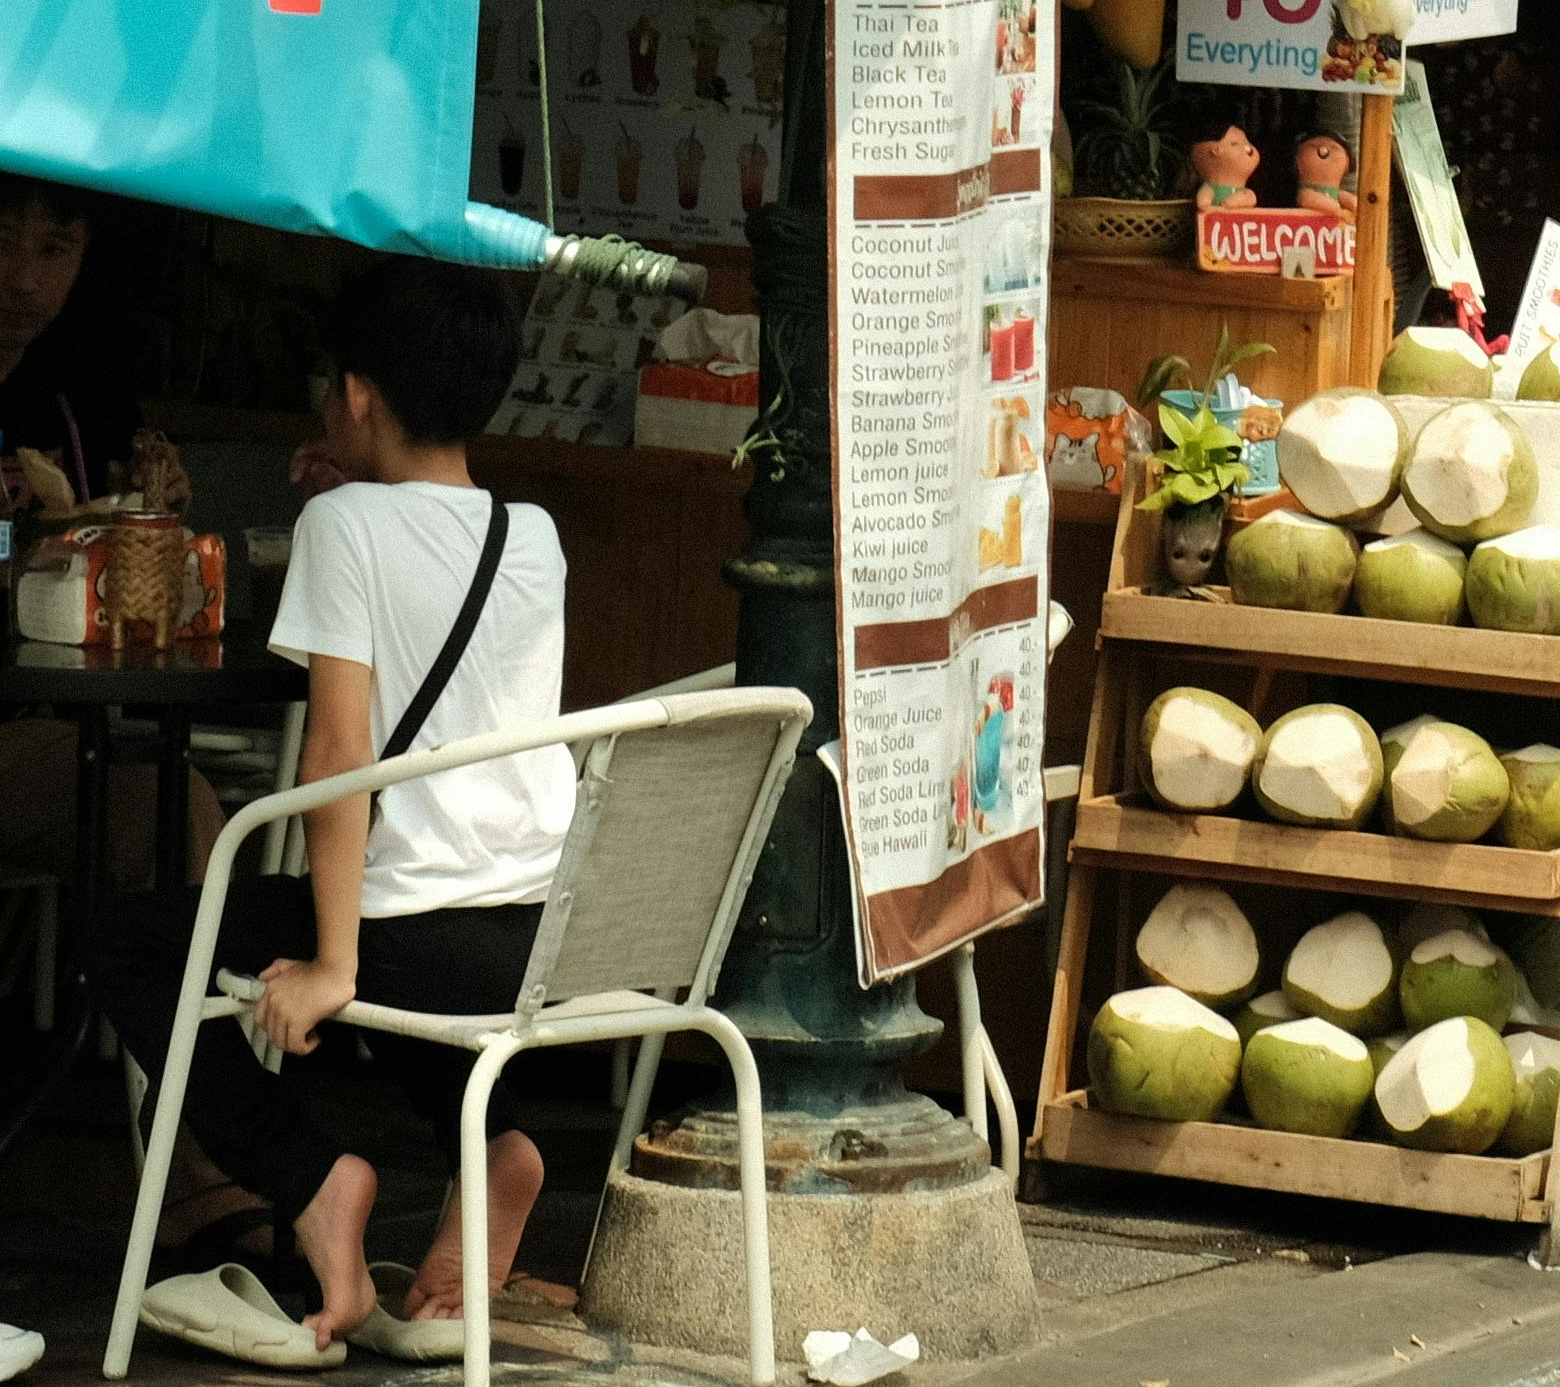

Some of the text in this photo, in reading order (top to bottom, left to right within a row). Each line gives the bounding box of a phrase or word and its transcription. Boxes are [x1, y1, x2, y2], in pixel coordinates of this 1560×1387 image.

[852, 15, 940, 34] Thai Tea
[852, 40, 945, 58] Iced Milk
[1186, 32, 1320, 77] Everyting
[851, 66, 947, 84] Black Tea
[851, 91, 923, 109] Lemon
[851, 117, 954, 138] Chrysanth
[851, 142, 955, 163] Fresh Sug
[851, 236, 932, 255] Coconut
[1209, 221, 1356, 264] WELCOME
[851, 261, 931, 280] Coconut
[851, 285, 953, 305] Watermelon
[851, 312, 920, 334] Orange
[851, 336, 939, 359] Pineapple
[851, 362, 945, 384] Strawberry
[851, 387, 945, 408] Strawberry
[851, 414, 916, 434] Banana
[850, 440, 899, 461] Apple
[851, 465, 909, 484] Lemon
[851, 490, 908, 509] Lemon
[851, 511, 927, 534] Alvocado
[852, 537, 928, 559] Kiwi juice
[851, 565, 908, 586] Mango
[851, 586, 945, 611] Mango juice
[853, 688, 887, 709] Pepsi
[853, 712, 898, 734] Orange
[902, 706, 943, 725] Juice
[856, 738, 878, 759] Red
[881, 734, 915, 753] Soda
[856, 764, 888, 784] Green
[892, 757, 931, 777] Soda
[880, 784, 914, 804] Soda
[893, 808, 928, 828] Soda
[882, 830, 929, 854] Hawaii
